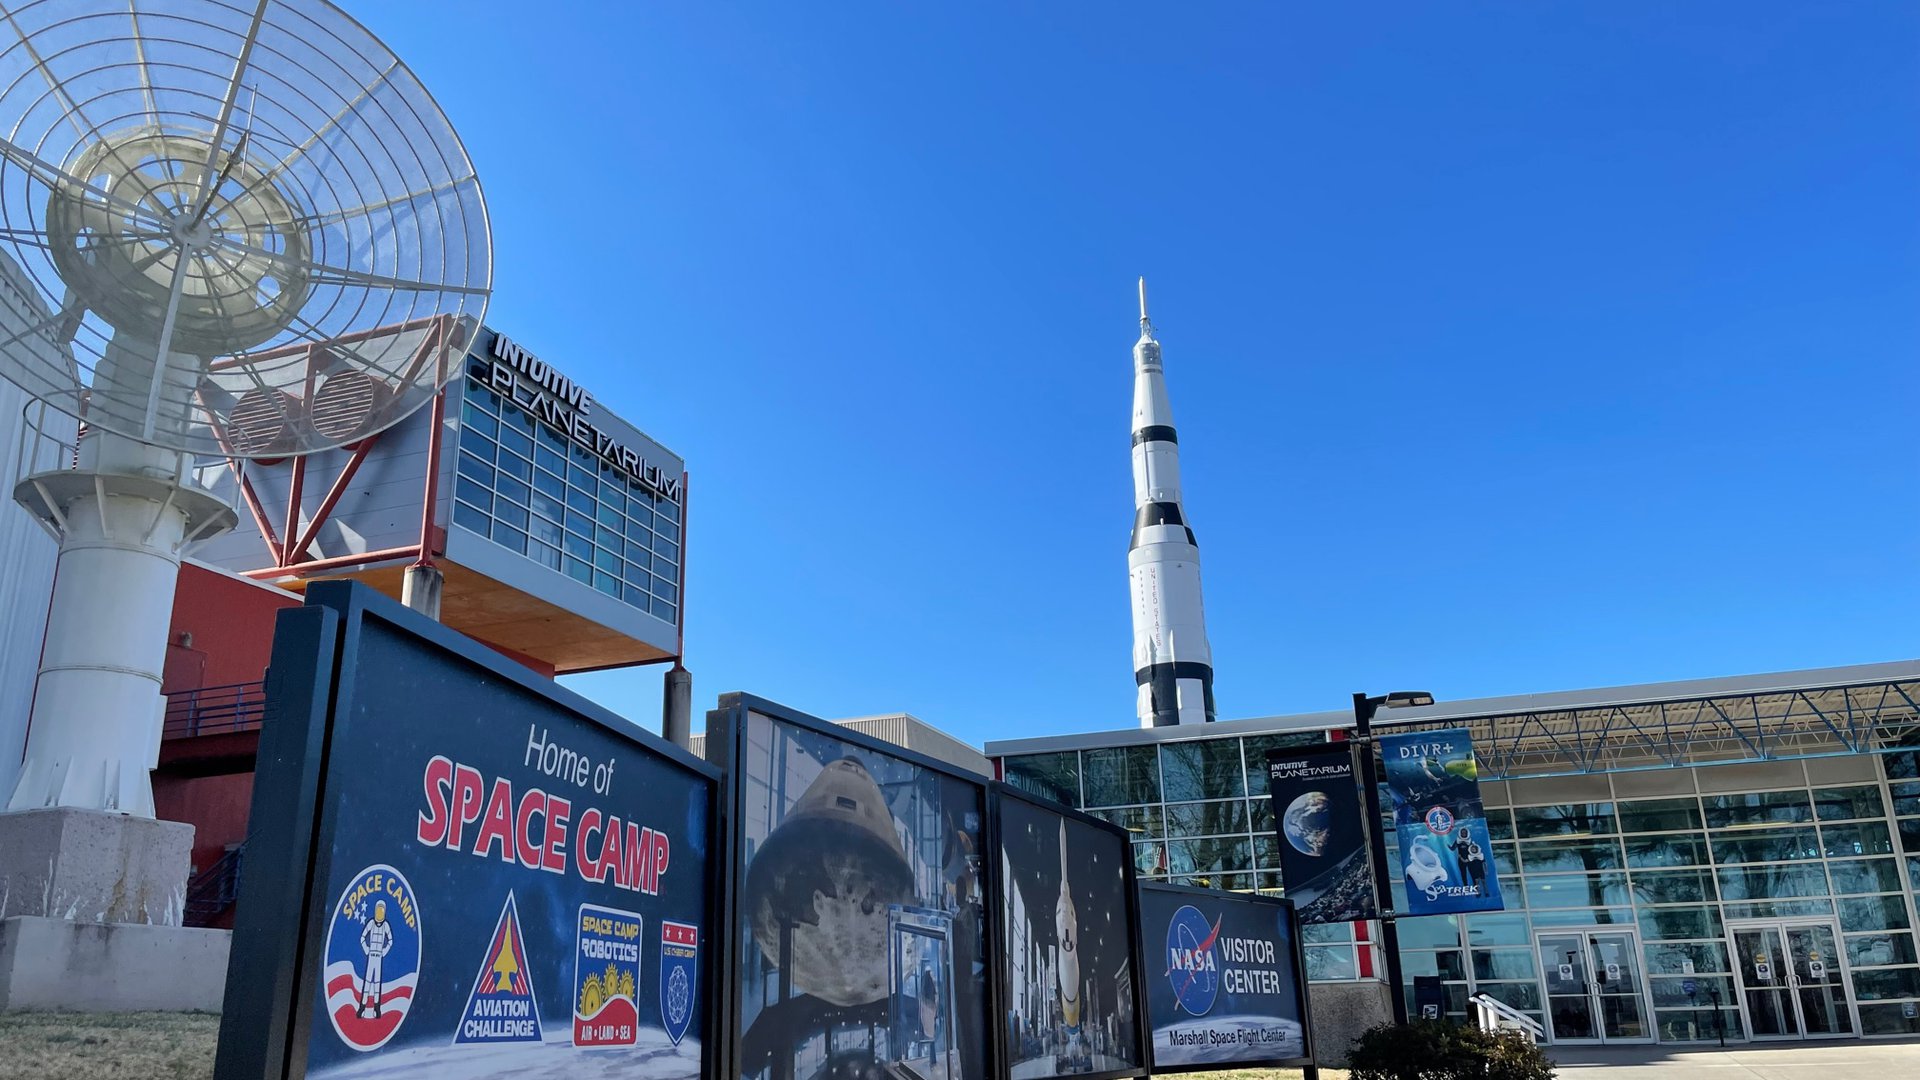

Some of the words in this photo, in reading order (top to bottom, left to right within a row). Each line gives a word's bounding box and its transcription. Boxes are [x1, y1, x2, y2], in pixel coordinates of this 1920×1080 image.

[493, 333, 593, 415] INTUITIVE
[491, 362, 679, 500] PLANETARIUM
[1150, 567, 1158, 605] UNITED
[1153, 608, 1161, 647] STATES
[524, 723, 589, 787] Home
[593, 758, 616, 795] of
[1400, 743, 1454, 759] DIVR+
[1271, 760, 1308, 771] INTUITIVE
[1271, 764, 1350, 779] PLANETARIUM
[417, 755, 572, 874] SPACE
[575, 807, 670, 896] CAMP
[343, 874, 383, 920] SPACE
[386, 878, 416, 928] CAMP
[582, 916, 613, 936] SPACE
[614, 921, 639, 940] CAMP
[581, 938, 638, 962] ROBOTICS
[1170, 948, 1216, 972] NASA
[1220, 937, 1275, 964] VISITOR
[1224, 969, 1280, 994] CENTER
[473, 999, 529, 1017] AVIATION
[464, 1020, 534, 1038] CHALLENGE
[581, 1025, 593, 1041] AIR
[598, 1026, 614, 1041] LAND
[619, 1026, 631, 1040] SEA
[1169, 1029, 1208, 1046] Marshall
[1210, 1030, 1236, 1047] Space
[1237, 1029, 1260, 1046] Flight
[1261, 1028, 1286, 1043] Center
